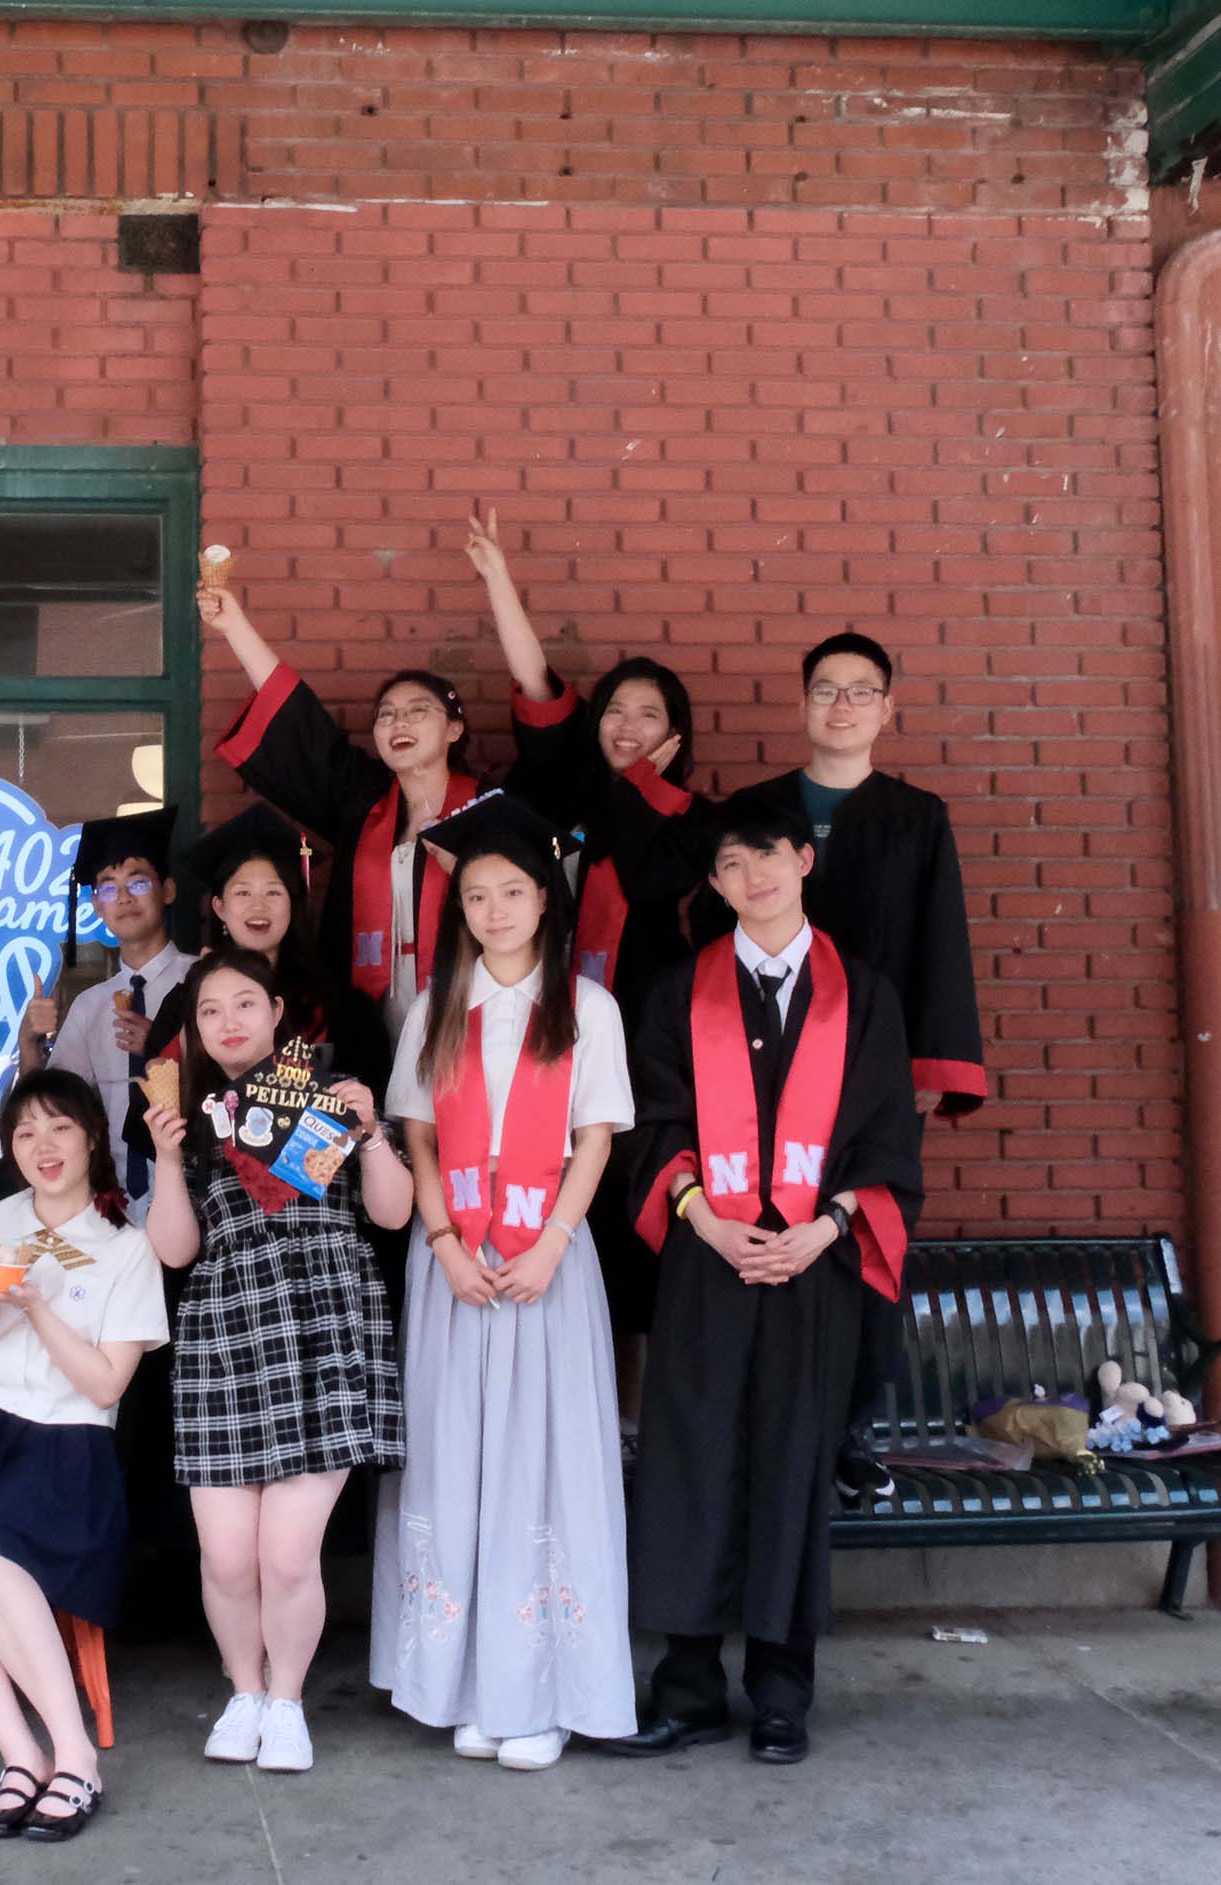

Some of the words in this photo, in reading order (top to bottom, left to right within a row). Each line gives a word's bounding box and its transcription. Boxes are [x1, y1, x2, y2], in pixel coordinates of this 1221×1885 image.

[356, 931, 384, 966] N
[277, 1063, 311, 1083] FOOD
[245, 1083, 311, 1109] PEILIN
[310, 1092, 347, 1116] ZHU
[304, 1114, 336, 1141] QUES
[708, 1151, 748, 1196] N
[782, 1141, 825, 1187] N
[449, 1166, 482, 1212] N
[502, 1183, 547, 1230] N
